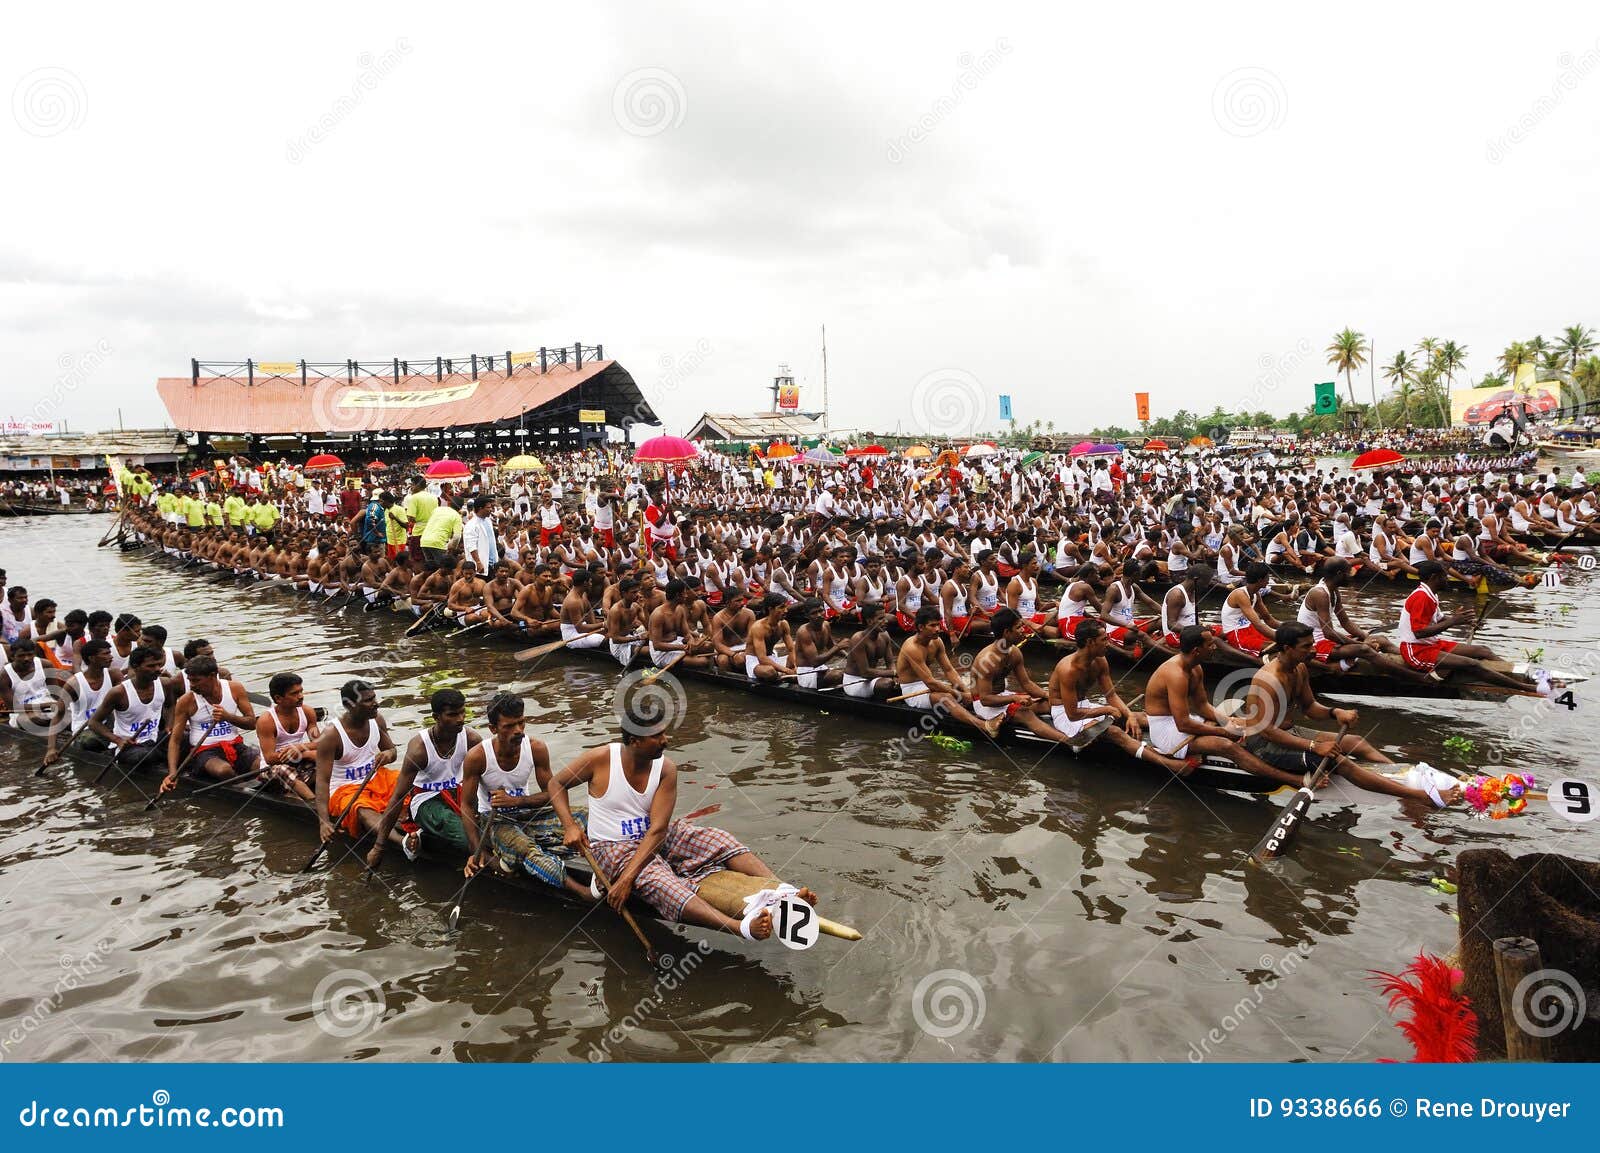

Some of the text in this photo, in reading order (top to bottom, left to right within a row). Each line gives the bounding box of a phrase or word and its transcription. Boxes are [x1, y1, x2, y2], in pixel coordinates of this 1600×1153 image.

[1321, 395, 1332, 409] 3
[1580, 556, 1594, 568] 10
[1545, 573, 1555, 587] 11
[1554, 691, 1577, 711] 4
[1562, 781, 1591, 814] 9
[779, 900, 811, 946] 12
